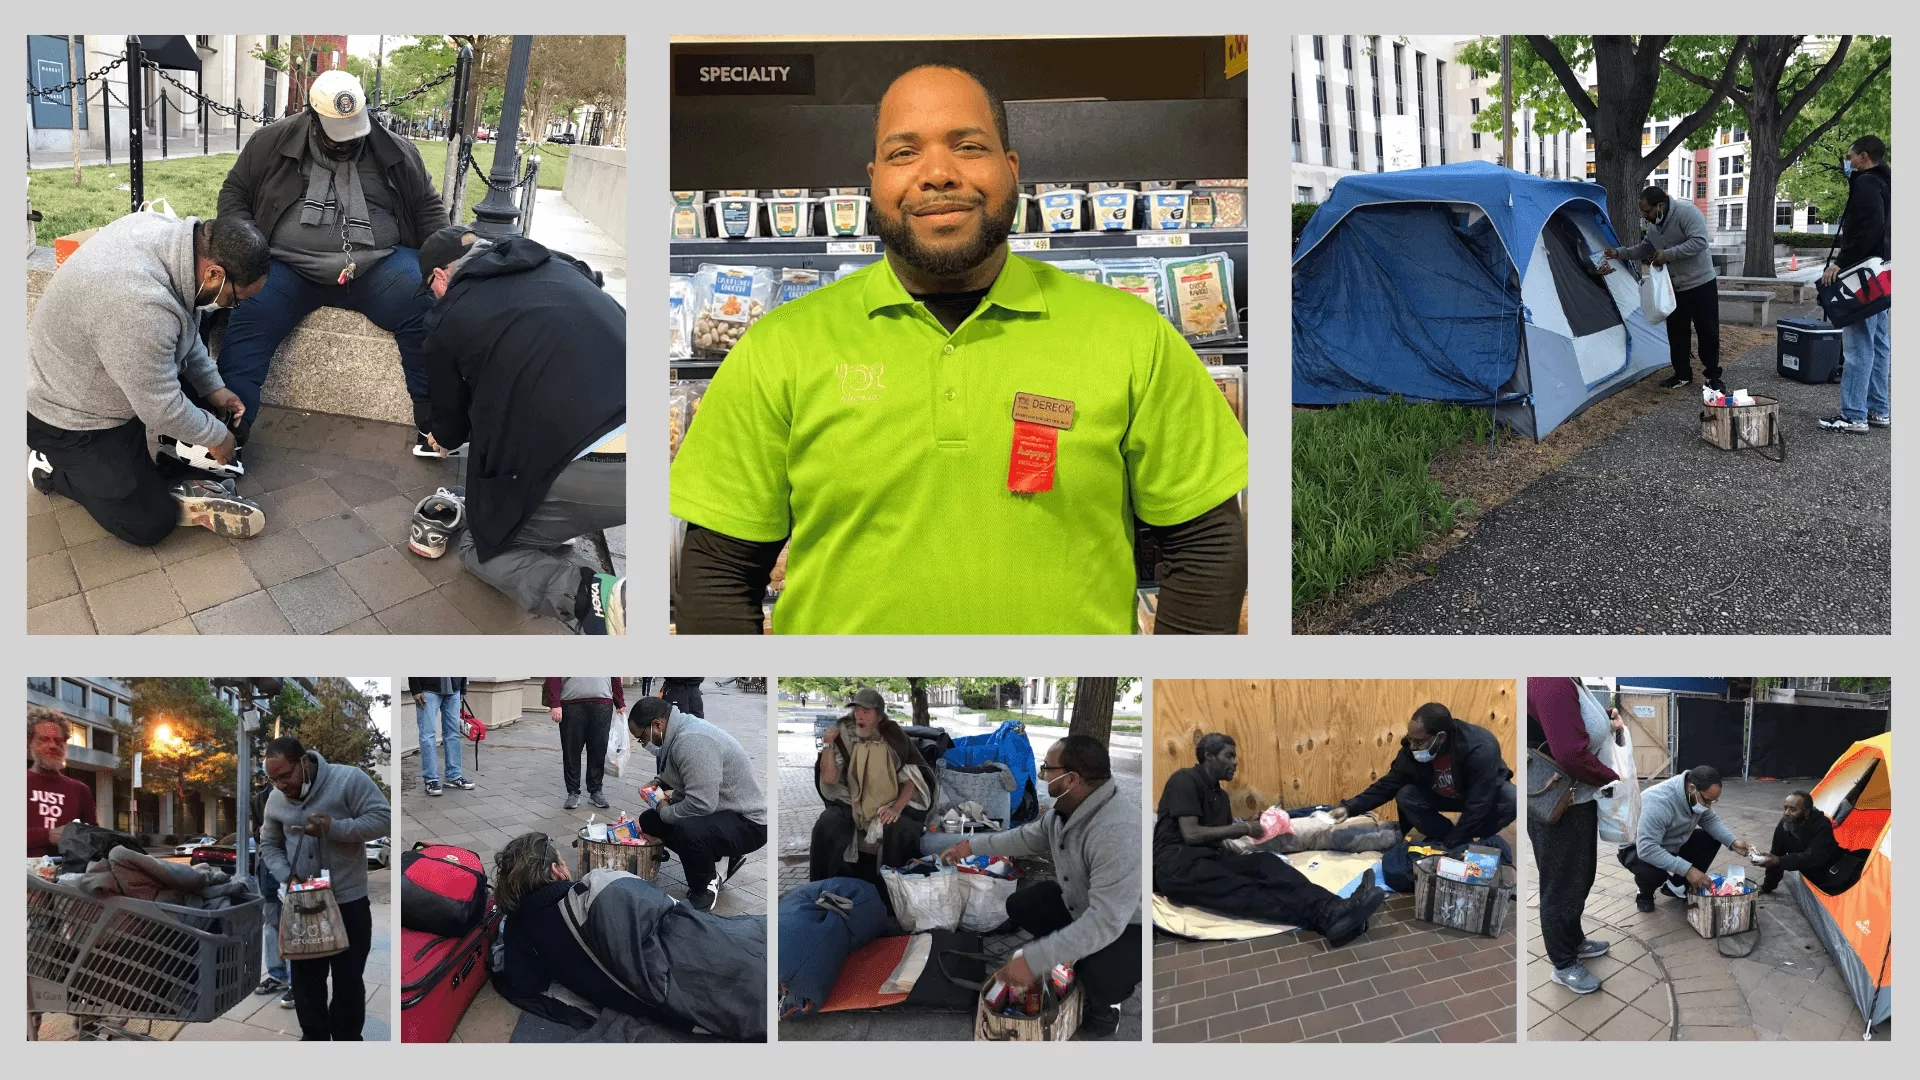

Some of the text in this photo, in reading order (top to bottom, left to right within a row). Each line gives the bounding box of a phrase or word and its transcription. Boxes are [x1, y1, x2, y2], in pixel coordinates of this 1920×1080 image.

[700, 66, 790, 81] SPECIALTY
[1032, 399, 1072, 414] DERECK
[591, 583, 605, 617] HOKA
[30, 790, 65, 805] JUST
[39, 803, 62, 817] DO
[44, 817, 57, 829] IT
[292, 936, 334, 945] groceries
